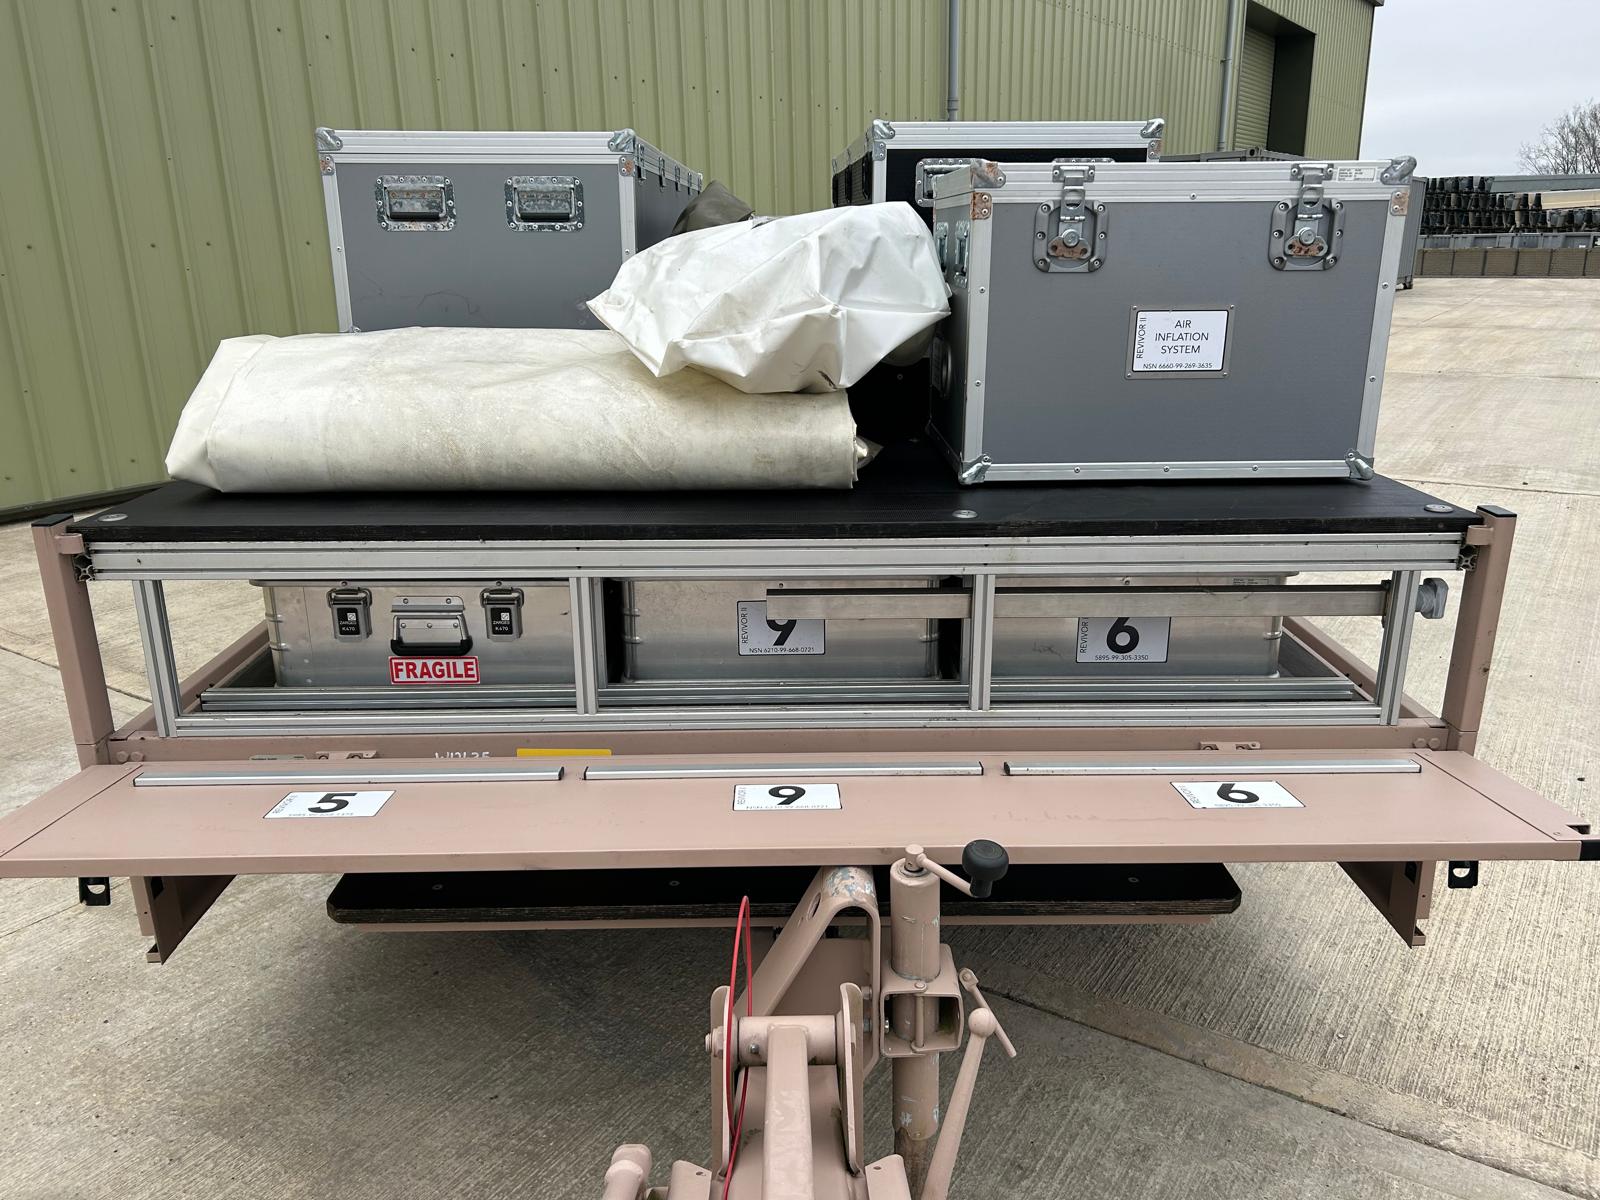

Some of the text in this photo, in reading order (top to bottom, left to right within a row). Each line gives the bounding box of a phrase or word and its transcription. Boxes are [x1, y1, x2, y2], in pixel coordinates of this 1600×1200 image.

[1174, 320, 1192, 329] AIR
[1136, 324, 1146, 358] REVIVOR
[1155, 332, 1209, 342] INFLATION
[1161, 345, 1201, 355] SYSTEM
[741, 613, 749, 644] REVIVOR
[766, 619, 797, 646] 9
[1080, 621, 1089, 654] REVIVOR
[1106, 617, 1140, 654] 6
[393, 661, 476, 679] FRAGILE
[308, 792, 358, 813] 5
[768, 785, 806, 806] 9
[1216, 783, 1260, 804] 6
